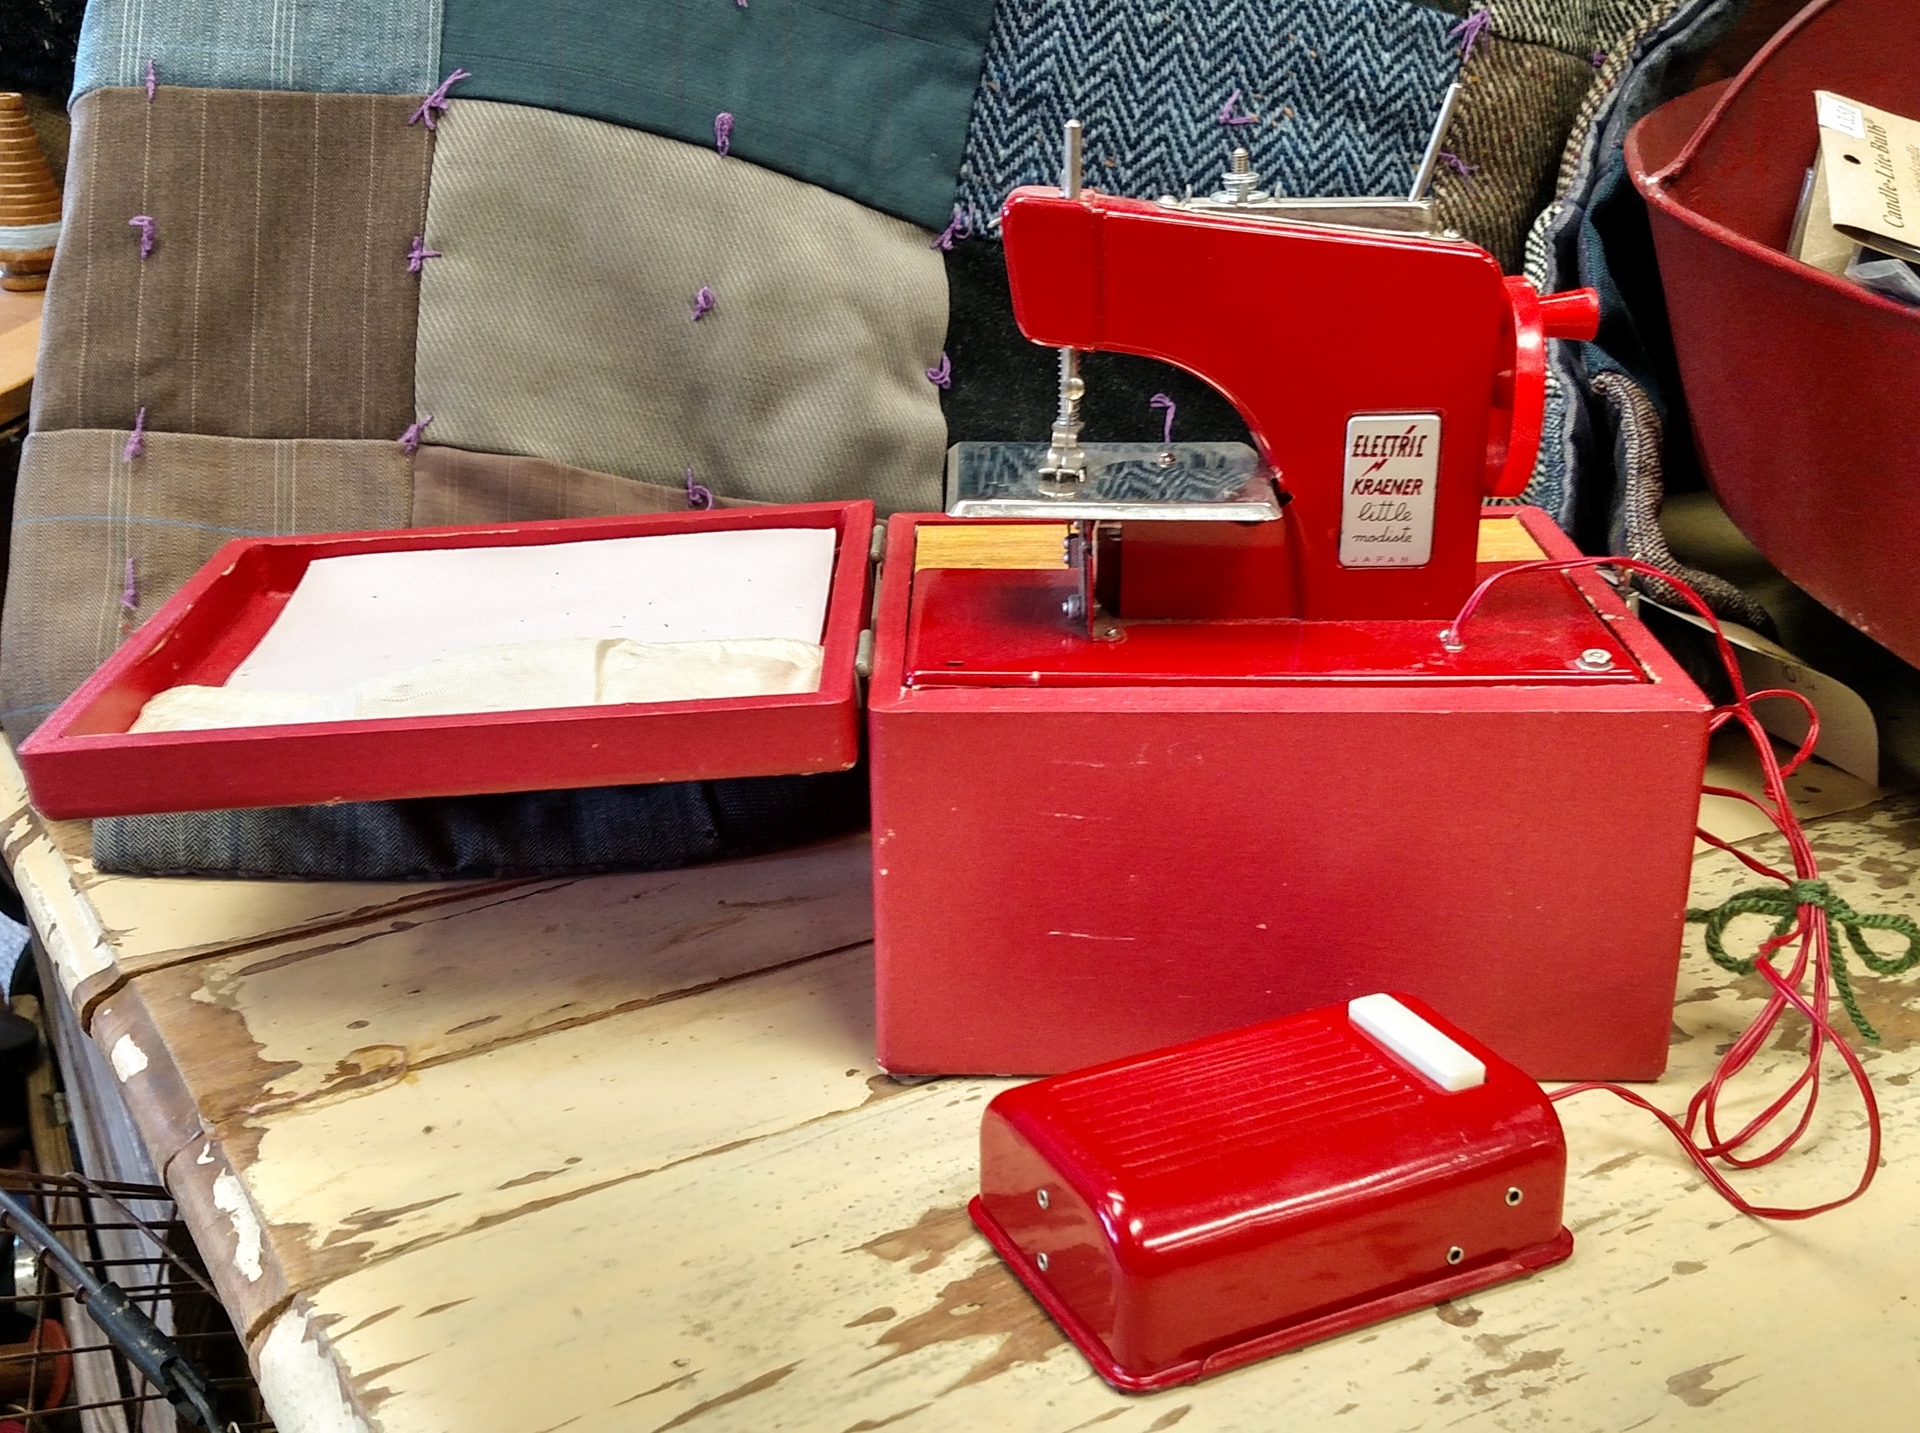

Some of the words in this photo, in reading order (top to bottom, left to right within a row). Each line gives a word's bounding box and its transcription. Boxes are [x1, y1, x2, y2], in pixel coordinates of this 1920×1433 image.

[1874, 154, 1905, 229] Candle-Lite
[1351, 434, 1428, 458] ELECTRIC
[1350, 478, 1424, 496] KRAEMER
[1357, 501, 1413, 522] little
[1351, 526, 1413, 543] modiste
